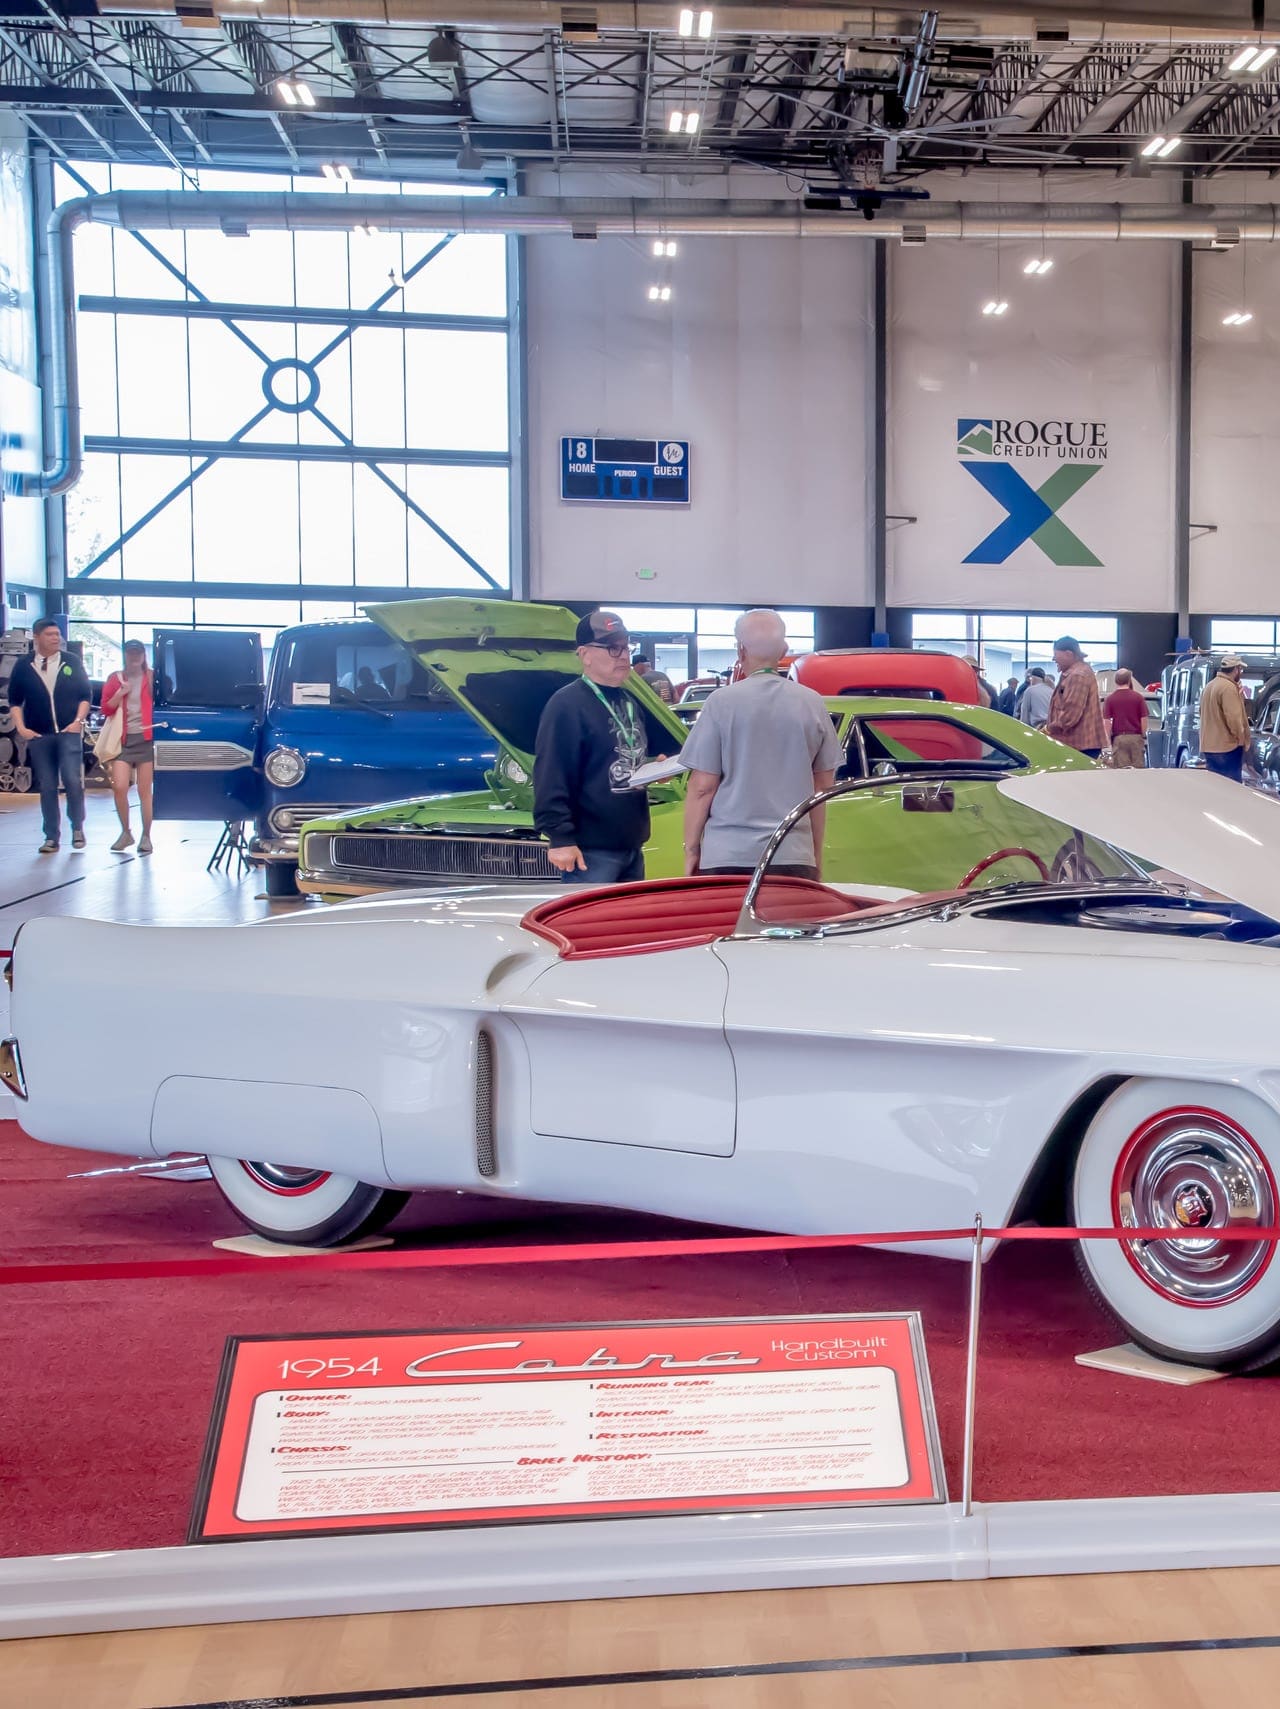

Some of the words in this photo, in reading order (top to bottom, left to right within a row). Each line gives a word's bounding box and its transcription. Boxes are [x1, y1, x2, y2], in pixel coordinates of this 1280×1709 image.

[994, 419, 1108, 447] ROGUE
[993, 444, 1050, 457] CREDIT
[1057, 447, 1108, 459] UNION
[568, 463, 596, 473] HOME
[614, 469, 637, 477] PERIOD
[653, 466, 684, 476] GUEST
[771, 1336, 888, 1352] Handbuilt
[405, 1341, 762, 1378] Cobra
[785, 1350, 877, 1361] Custom
[278, 1356, 383, 1379] 1954
[596, 1382, 668, 1390] RUNNING
[285, 1394, 352, 1402] OWNER:
[595, 1410, 674, 1418] INTERIOR:
[596, 1430, 709, 1439] RESTORATION:
[516, 1457, 567, 1466] BRIEF
[572, 1453, 652, 1463] HISTORY:
